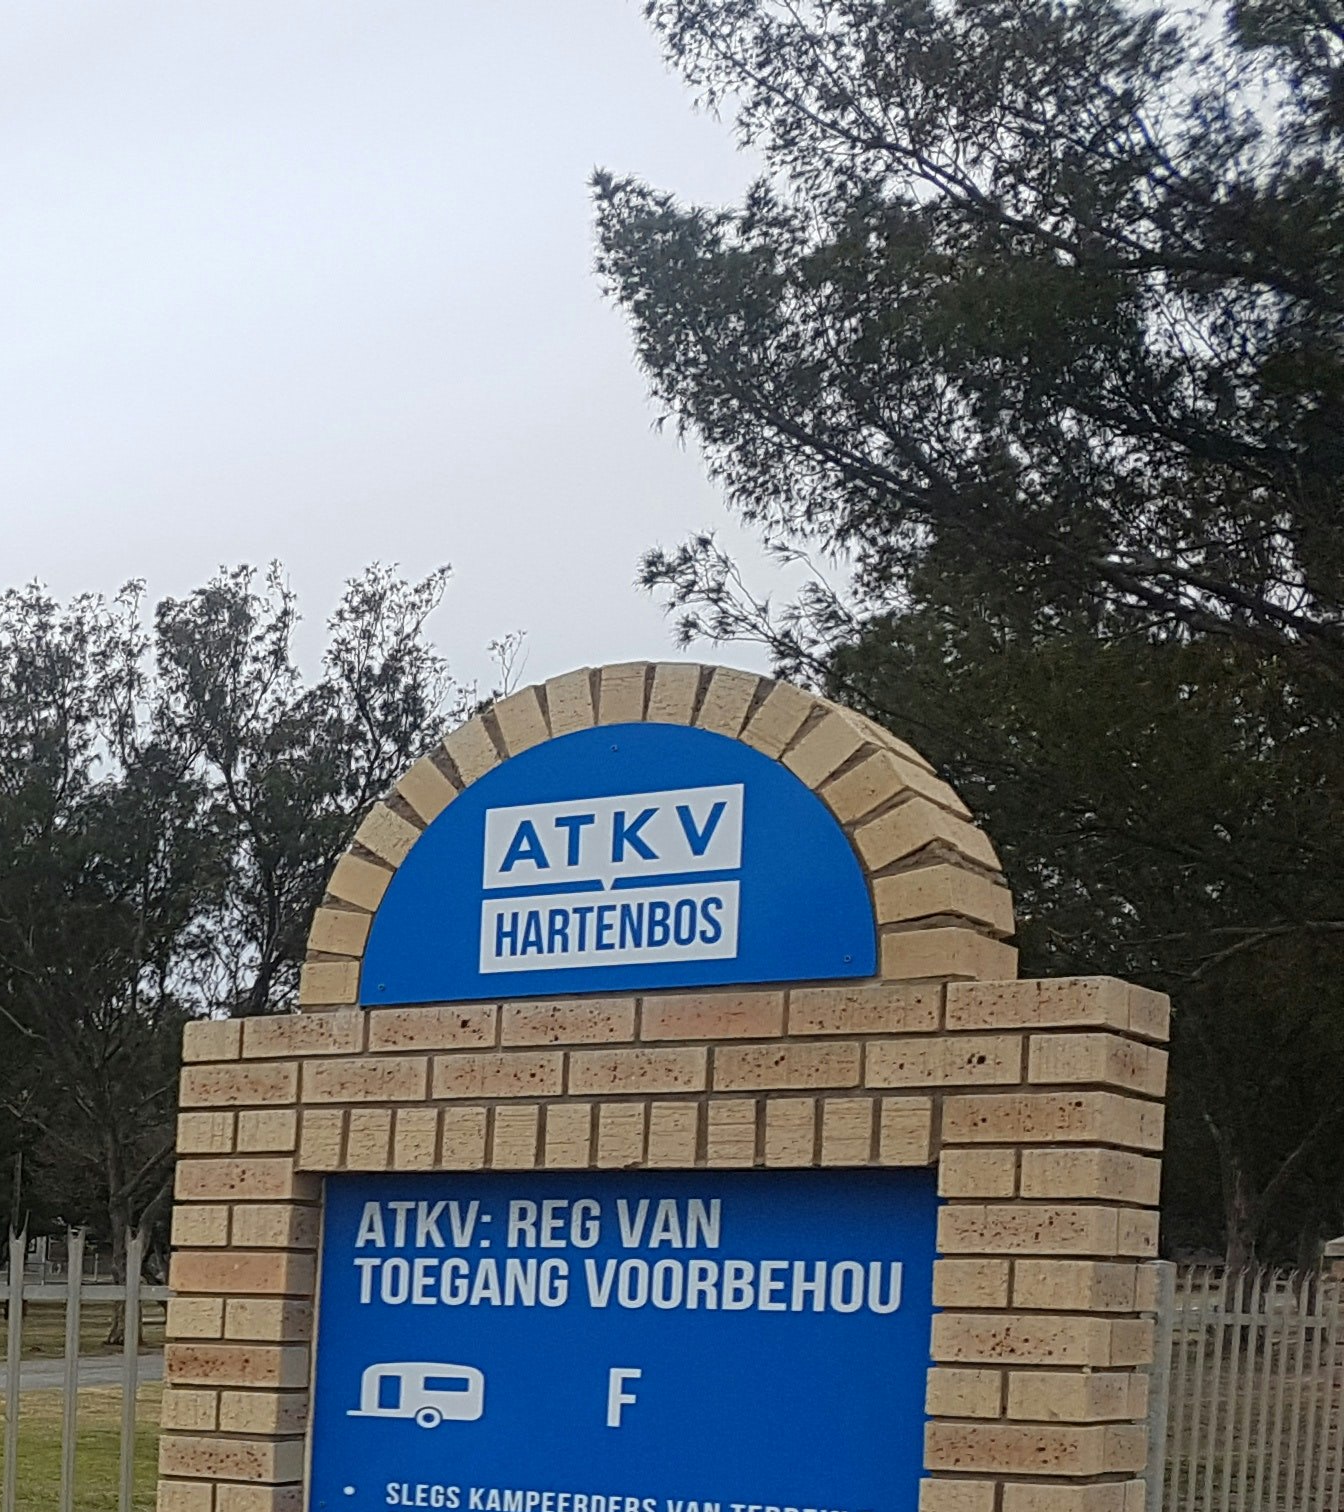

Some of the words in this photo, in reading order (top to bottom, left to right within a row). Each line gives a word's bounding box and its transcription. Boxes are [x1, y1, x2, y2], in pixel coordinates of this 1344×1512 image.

[498, 800, 728, 873] ATKV
[494, 896, 723, 958] HARTENBOS
[354, 1200, 492, 1249] ATKV:
[507, 1198, 601, 1249] REG
[617, 1198, 721, 1249] VAN
[353, 1256, 569, 1308] TOEGANG
[584, 1258, 903, 1314] VOORBEHOU
[606, 1367, 642, 1428] F
[386, 1482, 460, 1509] SLEGS
